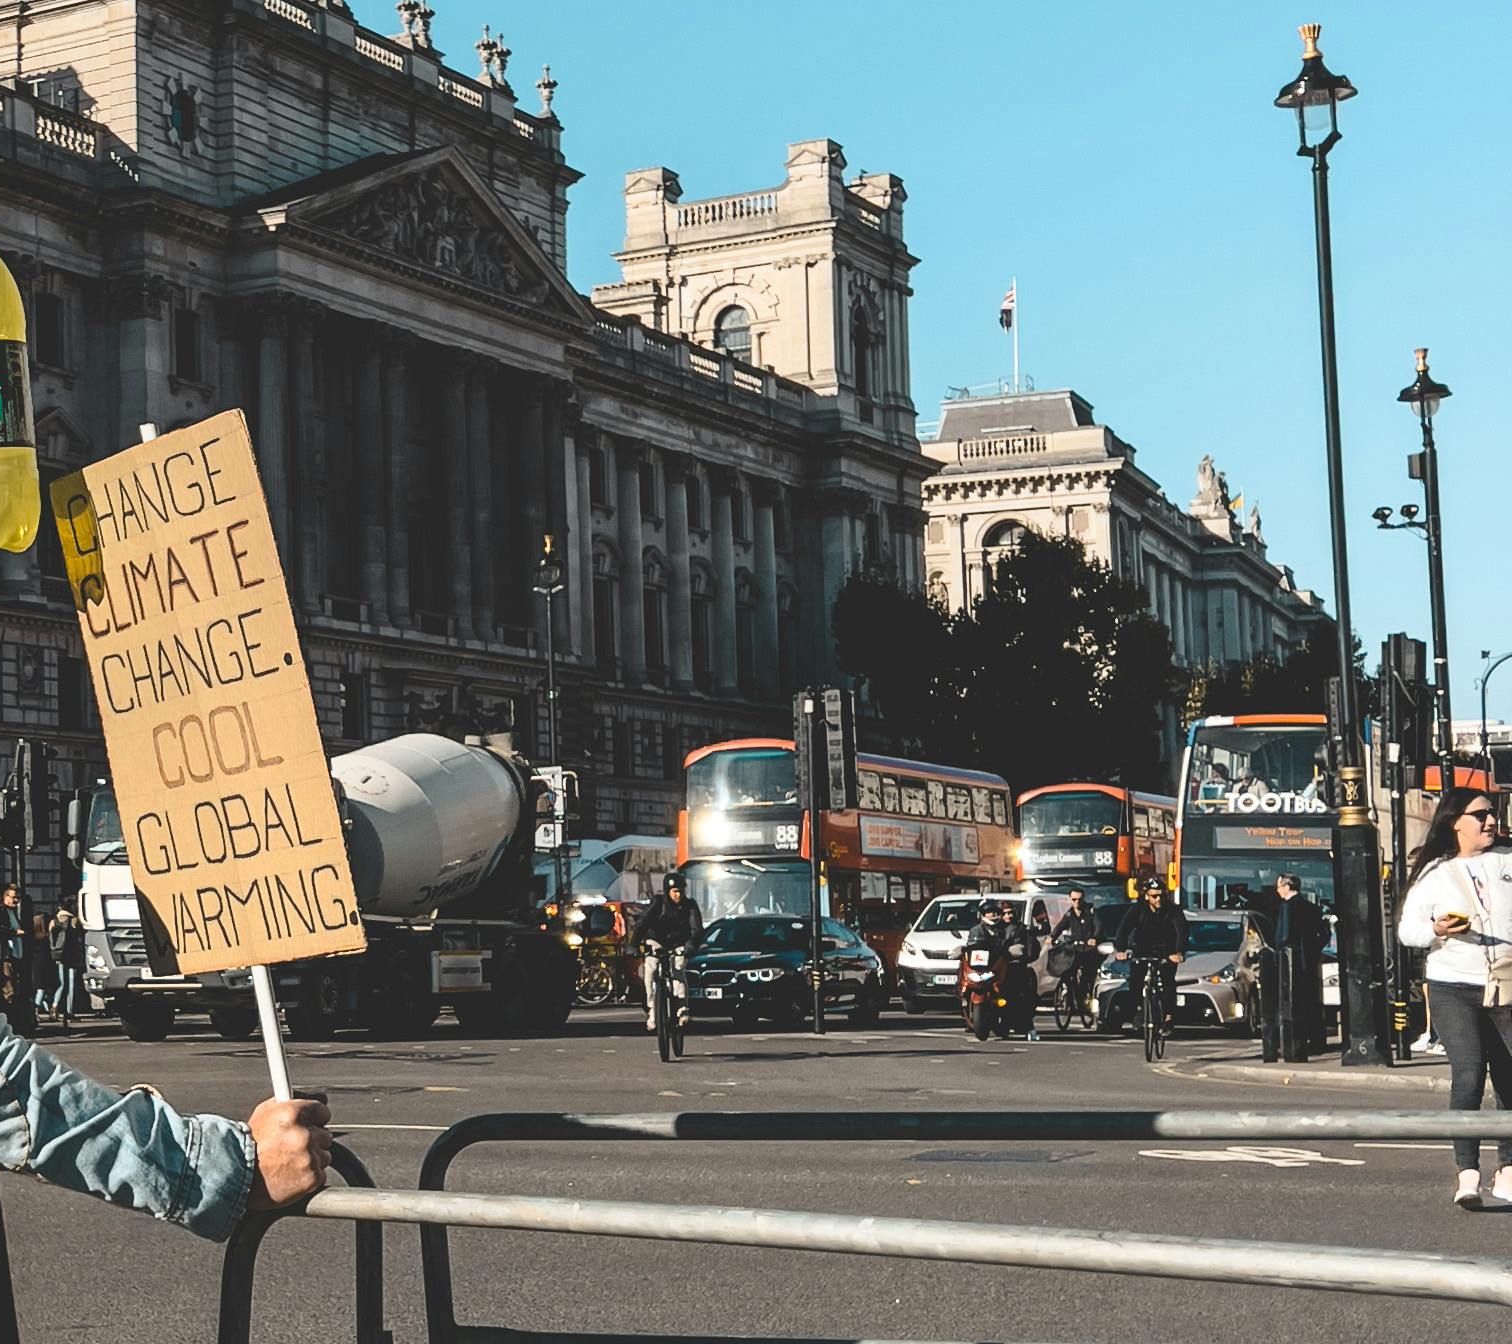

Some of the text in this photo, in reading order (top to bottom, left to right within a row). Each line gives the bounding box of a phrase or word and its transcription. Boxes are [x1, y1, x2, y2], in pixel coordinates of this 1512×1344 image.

[66, 437, 237, 556] CHANGE
[78, 519, 265, 639] CLIMATE
[100, 608, 294, 715] CHANGE.
[152, 701, 284, 790] COOL
[136, 783, 322, 875] GLOBAL
[776, 825, 799, 843] 88
[1224, 790, 1328, 813] TOOTBUS
[1095, 851, 1114, 865] 88
[1358, 1039, 1368, 1055] 6
